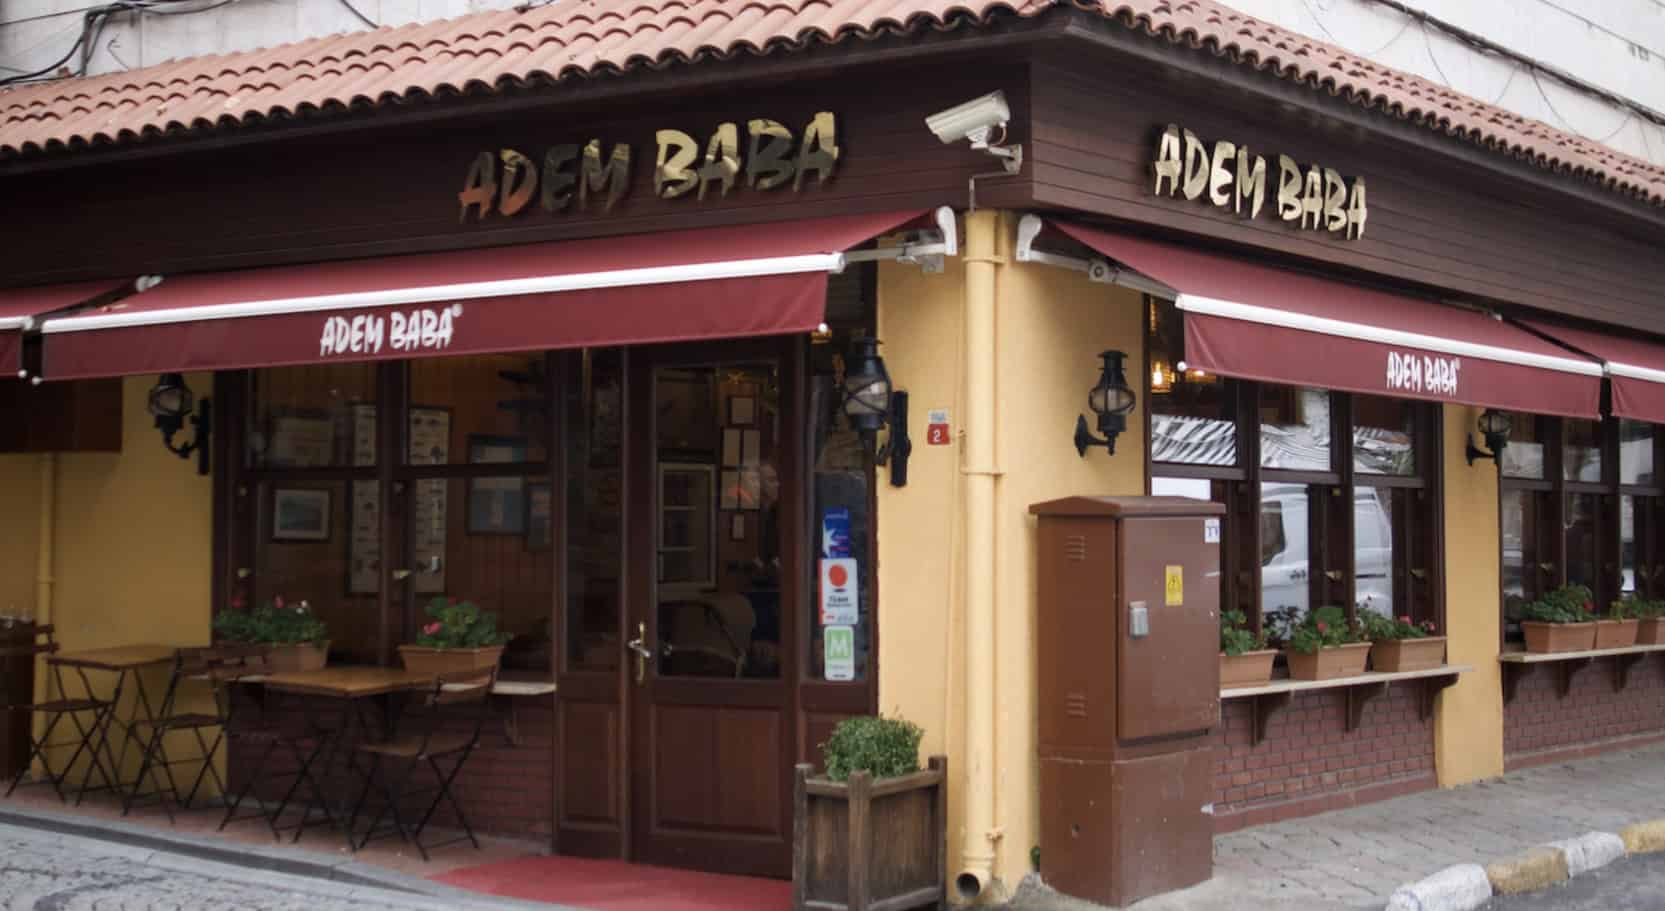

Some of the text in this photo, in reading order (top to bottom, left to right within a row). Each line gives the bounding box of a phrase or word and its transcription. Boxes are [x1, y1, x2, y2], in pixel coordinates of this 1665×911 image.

[459, 111, 839, 223] ADEM BABA
[1155, 123, 1367, 240] ADEM BABA
[319, 314, 385, 357] ADEM
[1386, 351, 1422, 393] ADEM
[932, 429, 942, 443] 2
[829, 633, 850, 657] M
